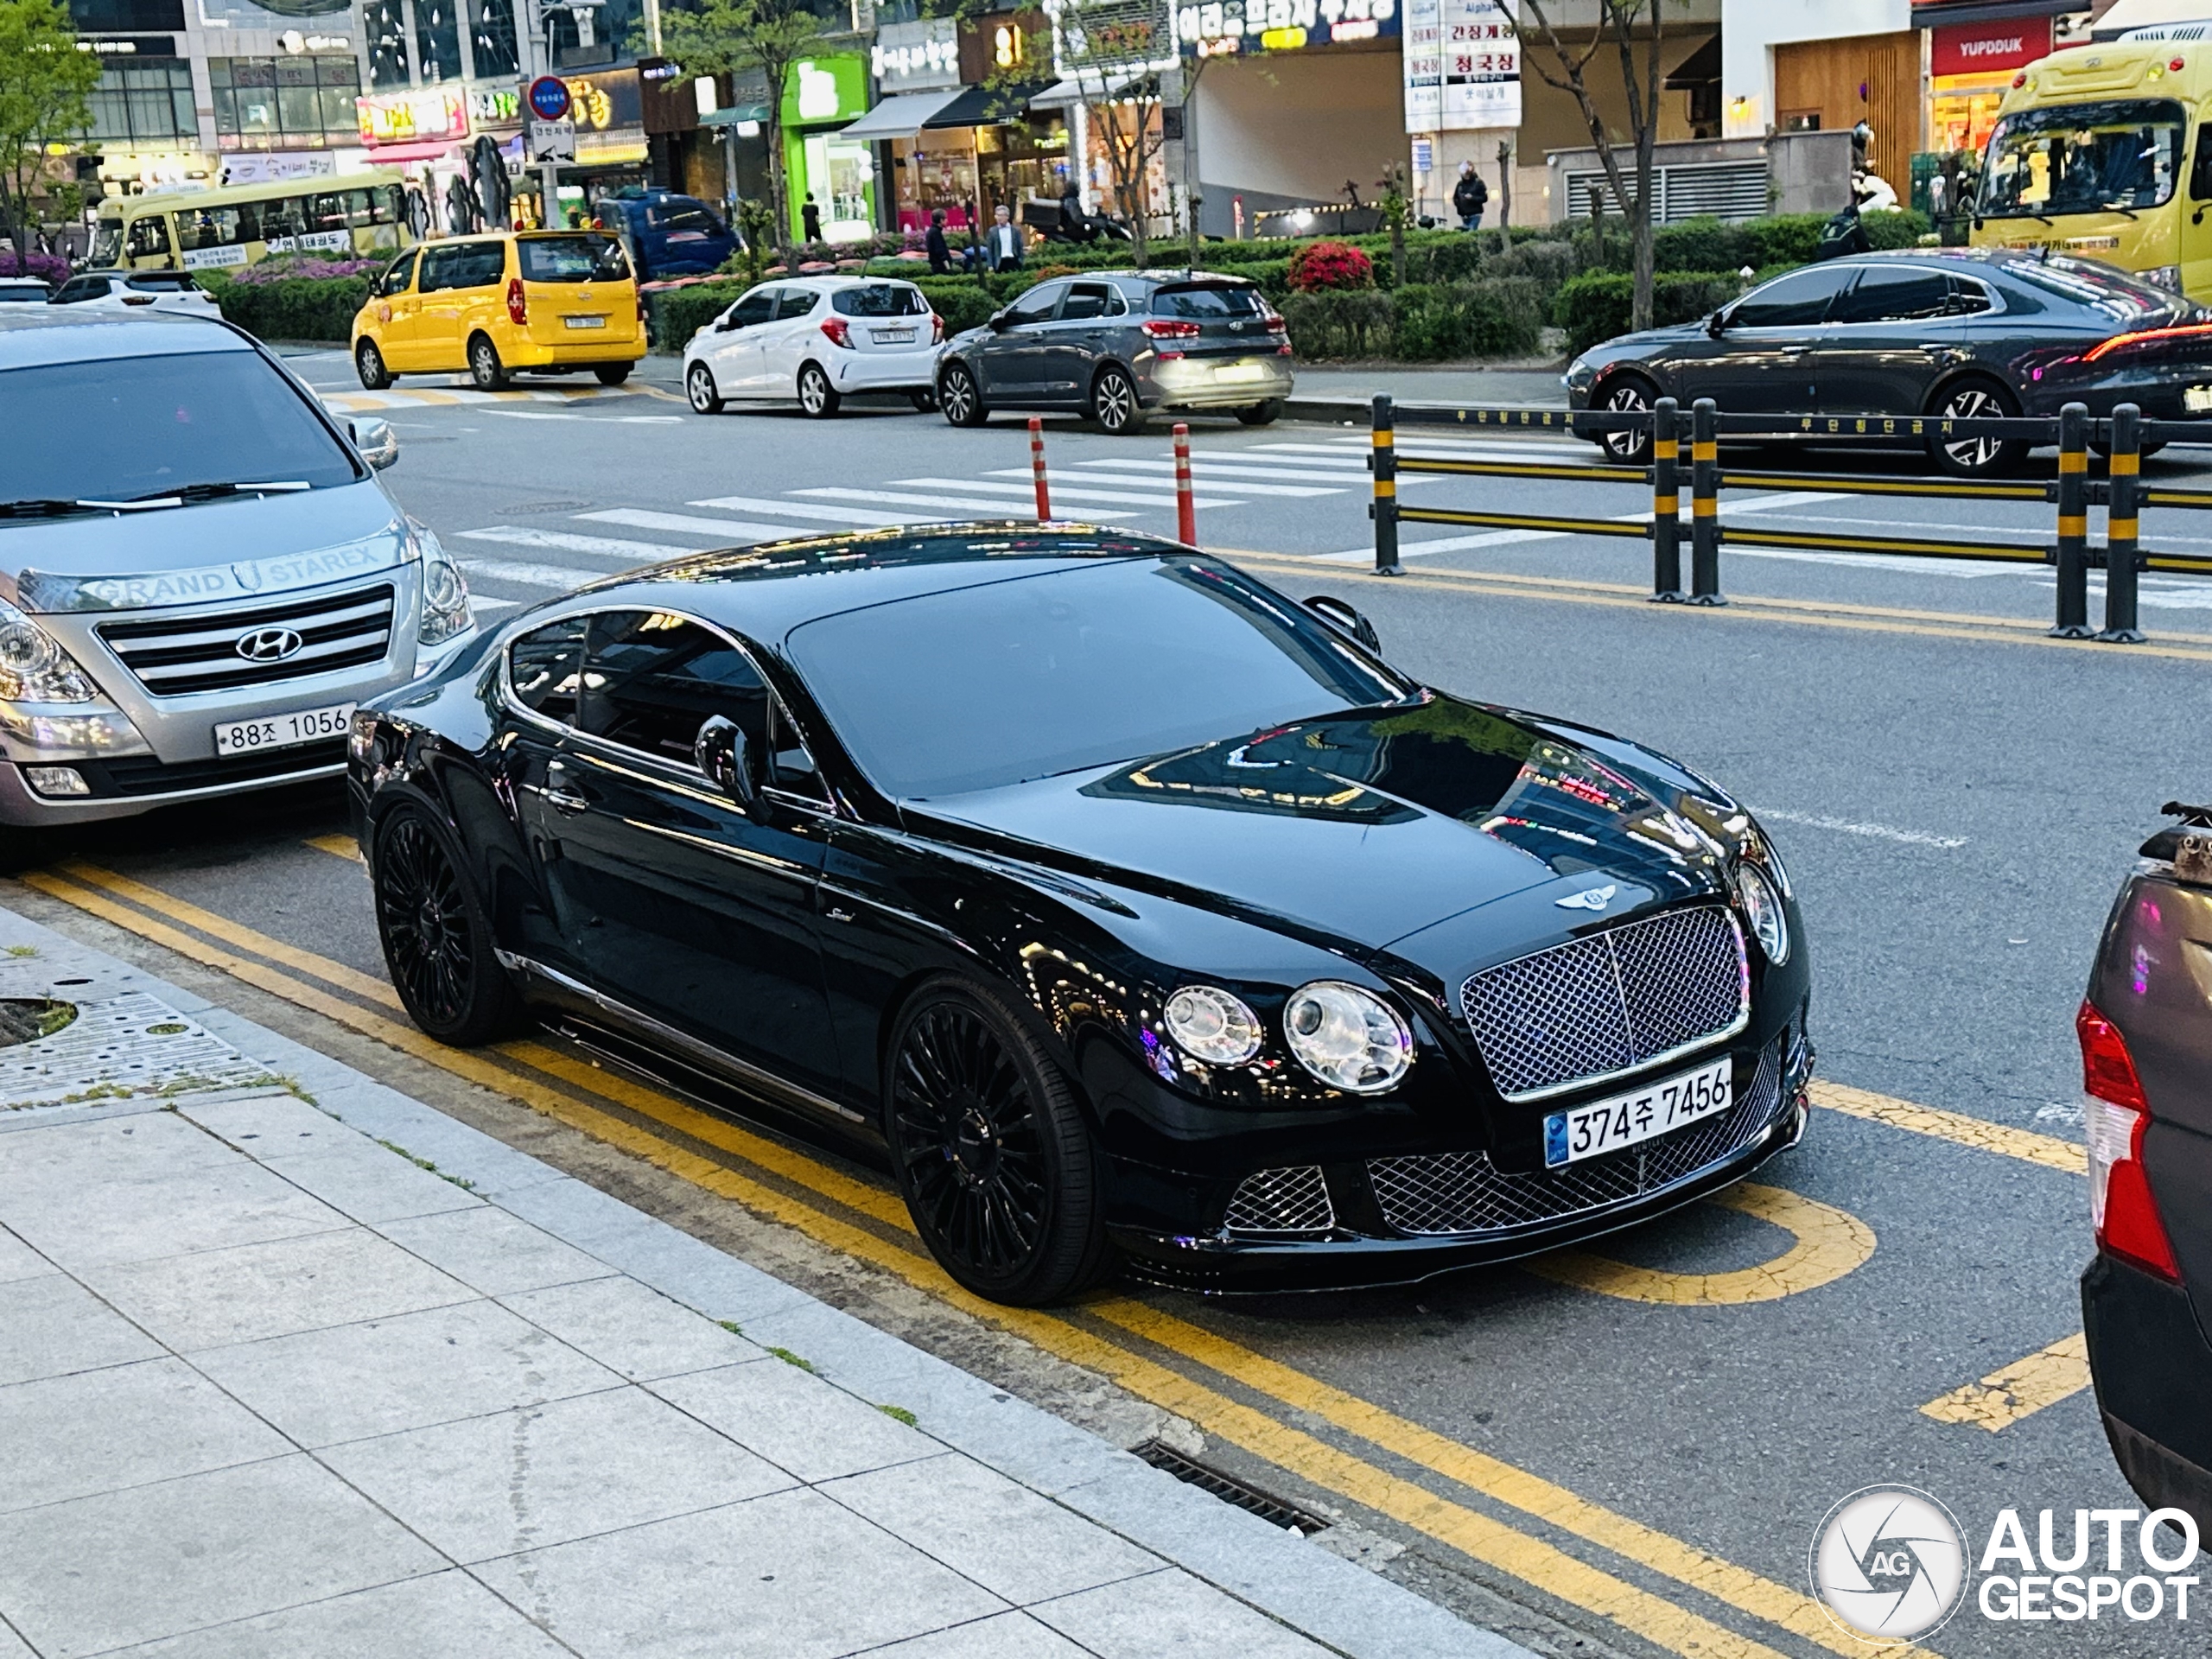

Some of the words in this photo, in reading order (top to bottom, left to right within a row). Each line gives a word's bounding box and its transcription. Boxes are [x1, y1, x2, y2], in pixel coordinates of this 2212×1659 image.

[1465, 3, 1492, 14] Alpha
[1960, 36, 2023, 57] YUPDDUK
[1455, 54, 1514, 73] 청국장
[1801, 418, 1953, 434] 무단횡단금지
[94, 573, 226, 602] GRAND
[269, 546, 378, 583] STAREX
[231, 722, 276, 748] 88조
[289, 709, 346, 738] 1056
[1573, 1097, 1653, 1153] 374주
[1662, 1068, 1726, 1125] 7456
